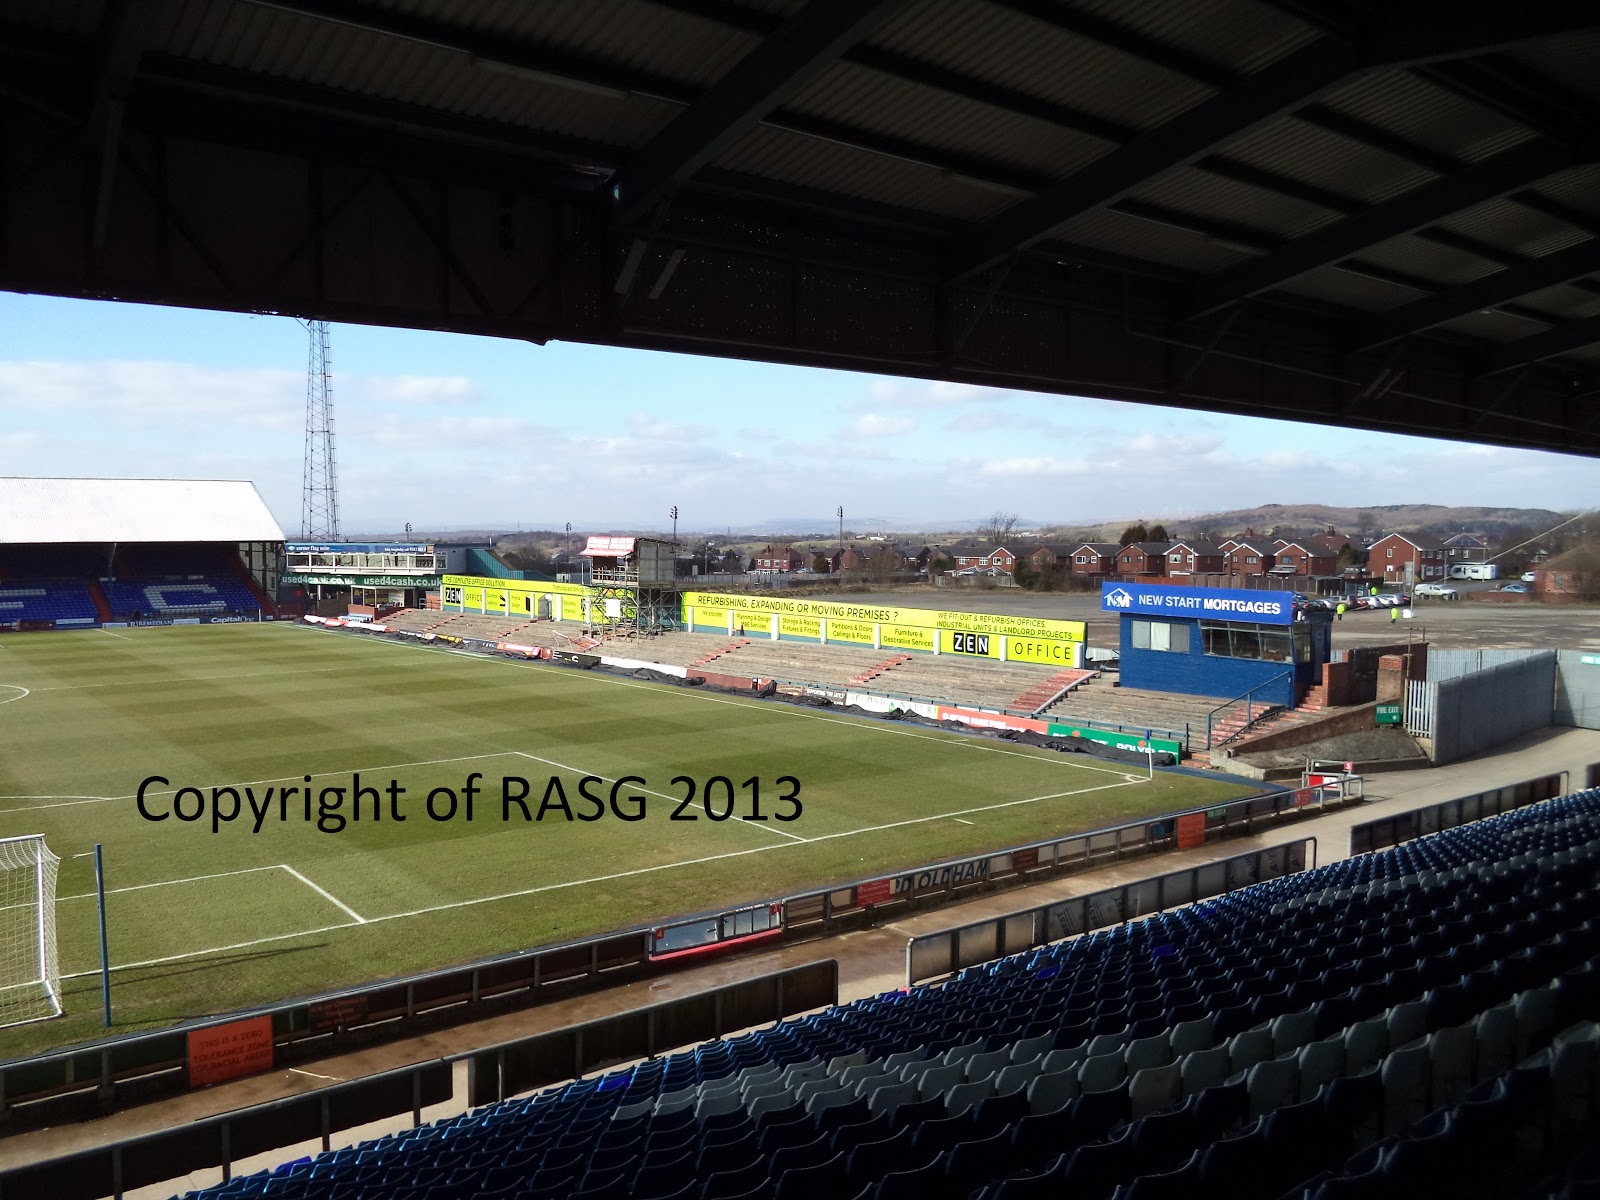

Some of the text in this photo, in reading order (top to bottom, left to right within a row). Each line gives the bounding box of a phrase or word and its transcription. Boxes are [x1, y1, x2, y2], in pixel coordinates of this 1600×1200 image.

[363, 576, 442, 587] used4cash.co.uk
[445, 588, 461, 603] ZEN
[698, 595, 748, 609] REFURBISHING,
[751, 599, 795, 612] EXPANDING
[796, 603, 809, 614] OR
[811, 604, 844, 617] MOVING
[847, 607, 890, 621] PREMISES
[1138, 594, 1281, 615] NEW START MORTGAGES
[783, 617, 798, 625] Storage
[804, 619, 820, 627] Racking
[831, 622, 853, 631] Partitions
[980, 615, 1015, 625] REFURBISH
[783, 625, 799, 633] Fixtures
[857, 632, 872, 640] Floors
[895, 628, 918, 637] Furniture
[937, 620, 971, 630] INDUSTRIAL
[973, 624, 991, 632] UNITS
[1000, 627, 1036, 636] LANDLORD
[1038, 629, 1073, 639] PROJECTS
[884, 635, 934, 647] Decorative Services
[954, 634, 989, 653] ZEN
[1014, 642, 1071, 660] OFFICE
[1388, 706, 1399, 714] EXIT
[918, 858, 988, 889] OLDHAM
[200, 1028, 264, 1048] THIS IS A ZERO
[193, 1039, 271, 1063] TOLERANCE ZONE
[211, 1057, 242, 1070] RACIAL
[245, 1048, 272, 1061] ABUSE
